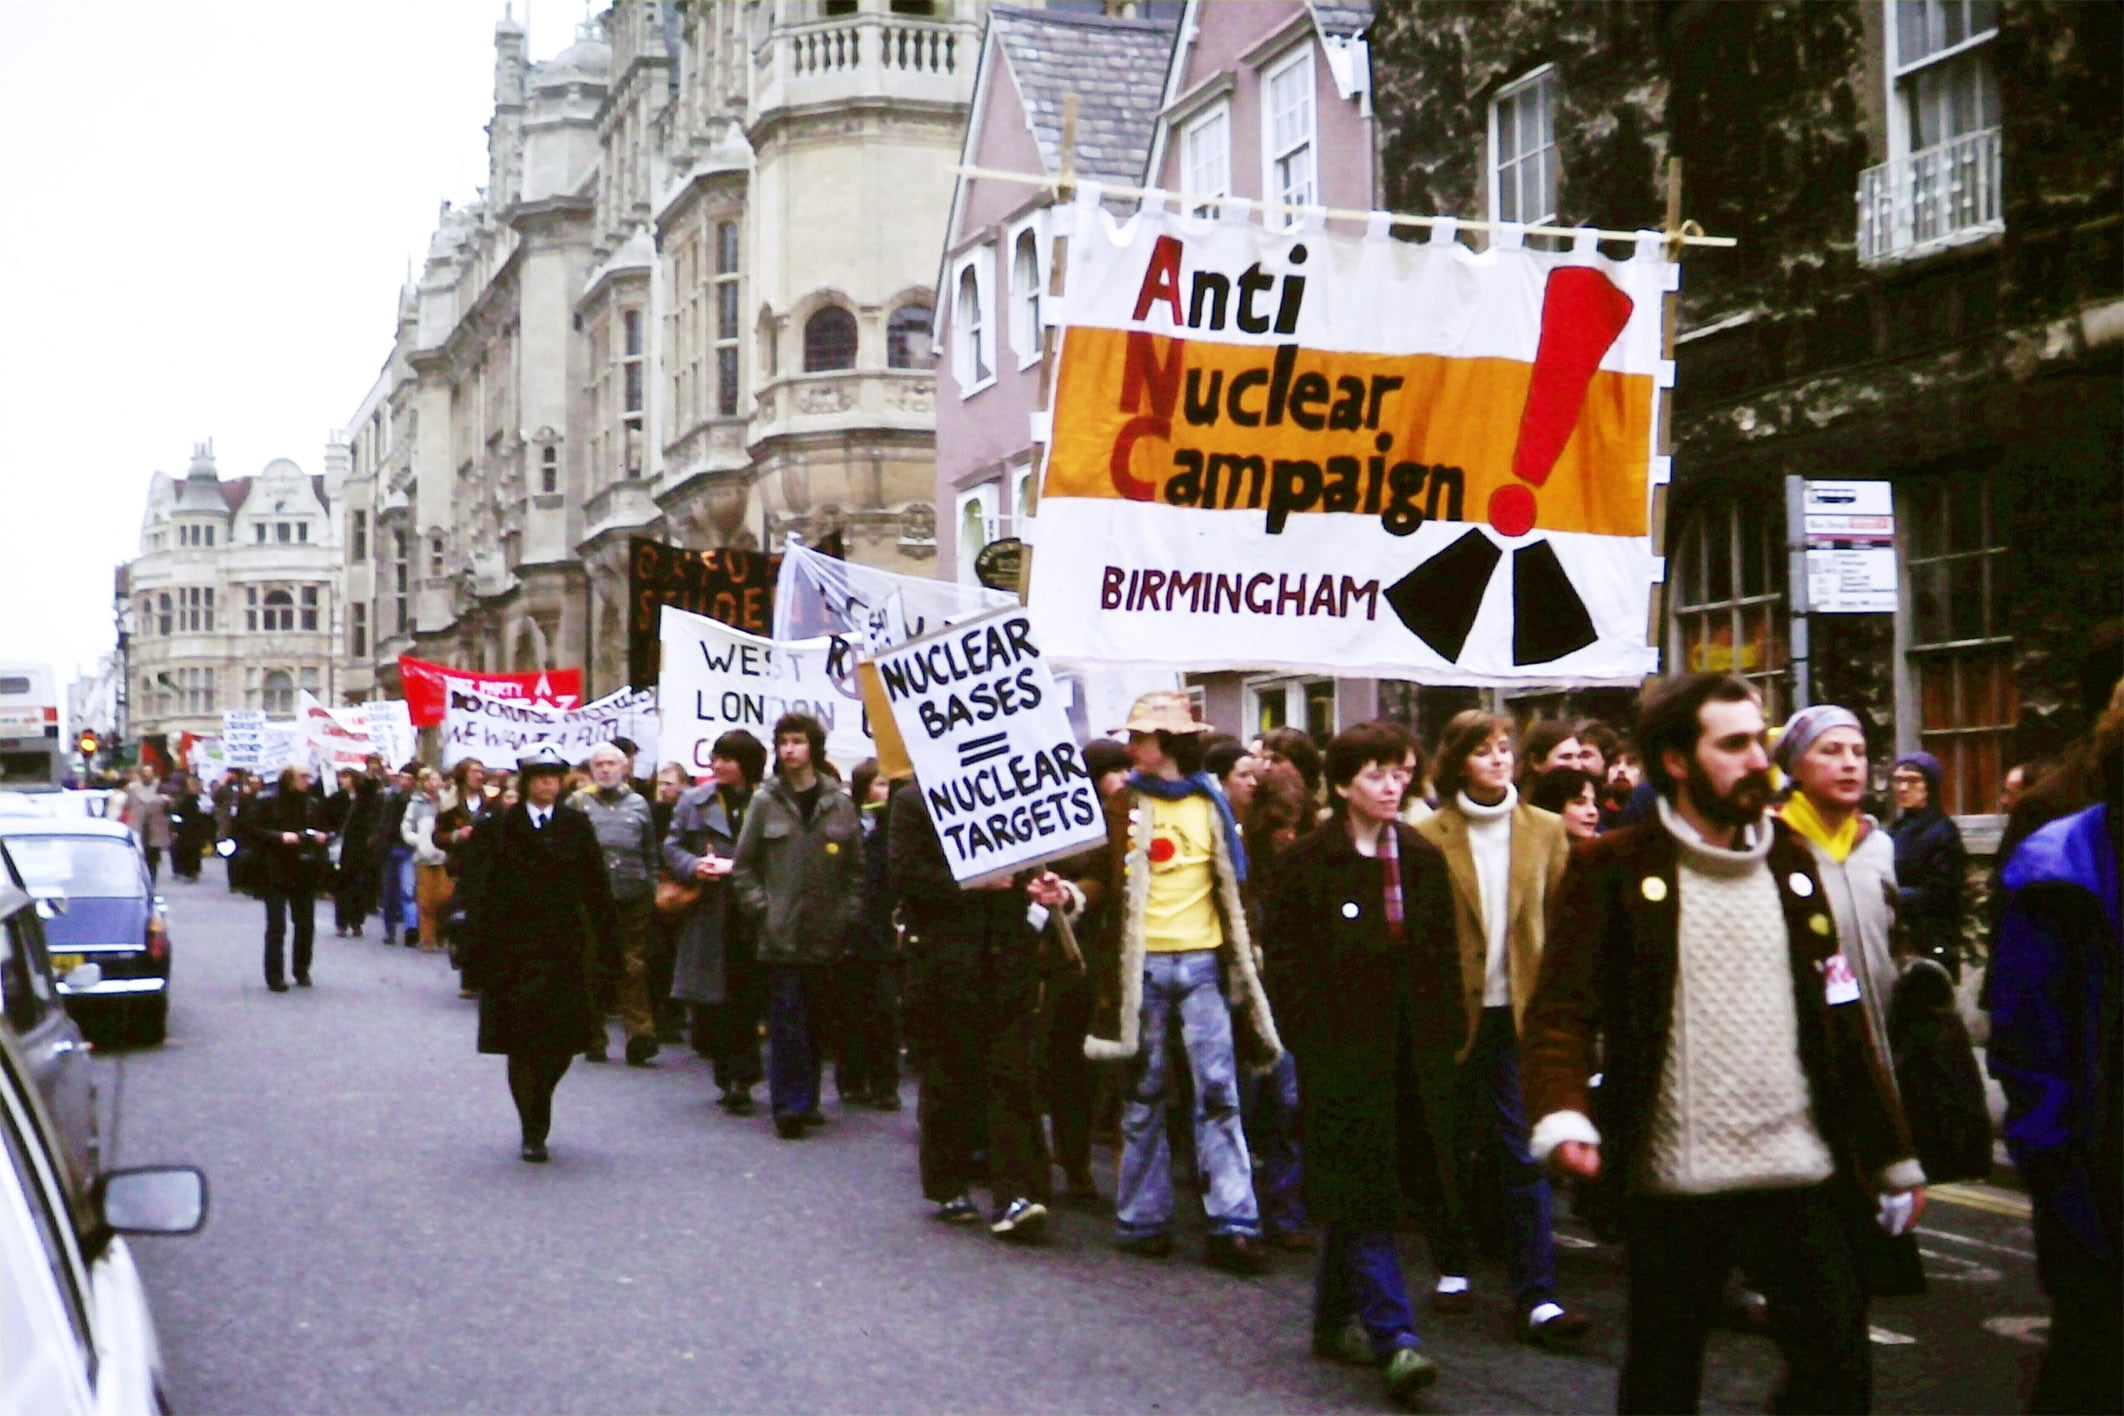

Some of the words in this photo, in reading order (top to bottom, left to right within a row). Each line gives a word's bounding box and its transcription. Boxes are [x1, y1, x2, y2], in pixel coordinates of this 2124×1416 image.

[1132, 235, 1308, 335] Anti
[1119, 330, 1404, 431] Nuclear
[1109, 417, 1466, 536] Campaign
[1101, 565, 1379, 620] BIRMINGHAM
[700, 640, 804, 682] WEST
[881, 618, 1040, 702] NUCLEAR
[919, 667, 1042, 739] BASES
[928, 742, 1089, 822] NUCLEAR
[943, 787, 1095, 861] TARGETS
